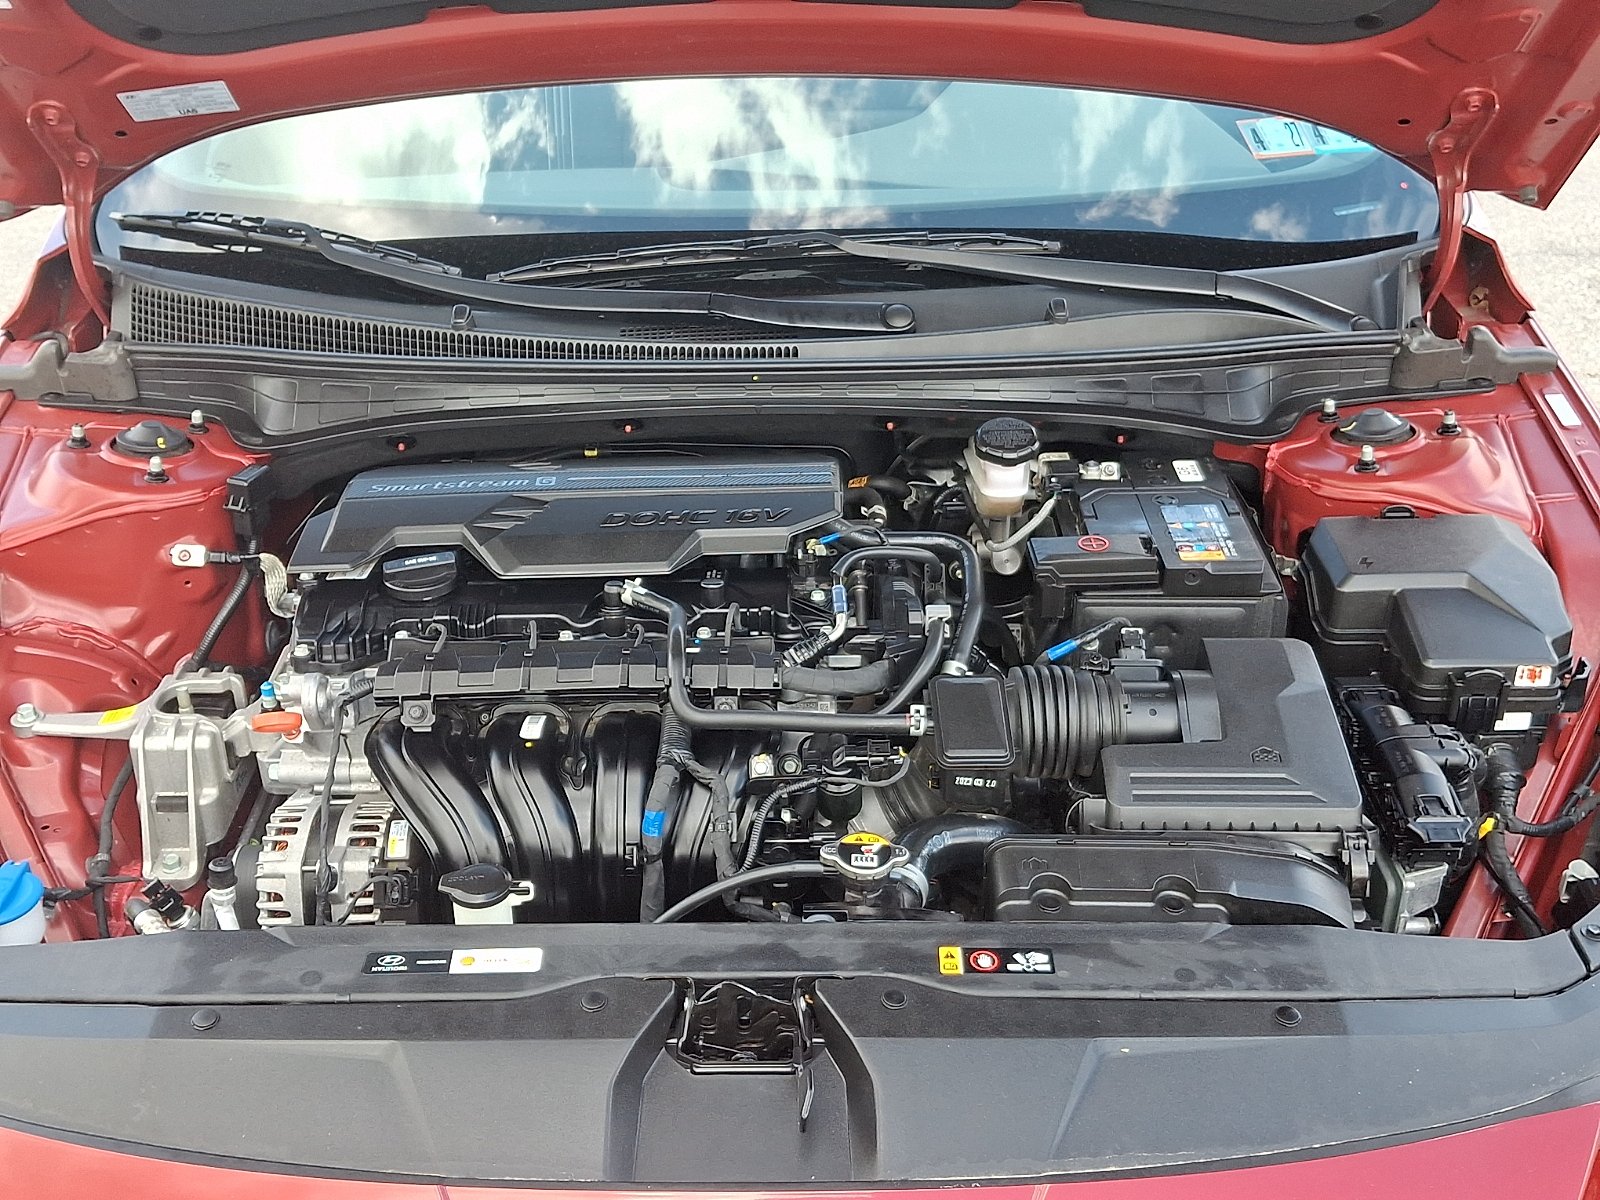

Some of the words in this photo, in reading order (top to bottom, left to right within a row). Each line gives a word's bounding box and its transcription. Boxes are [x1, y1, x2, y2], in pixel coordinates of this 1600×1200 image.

[1249, 127, 1268, 151] 4
[1284, 121, 1305, 147] 27
[367, 479, 530, 493] Smartstream
[600, 509, 717, 527] DOHC
[725, 507, 793, 523] 16V
